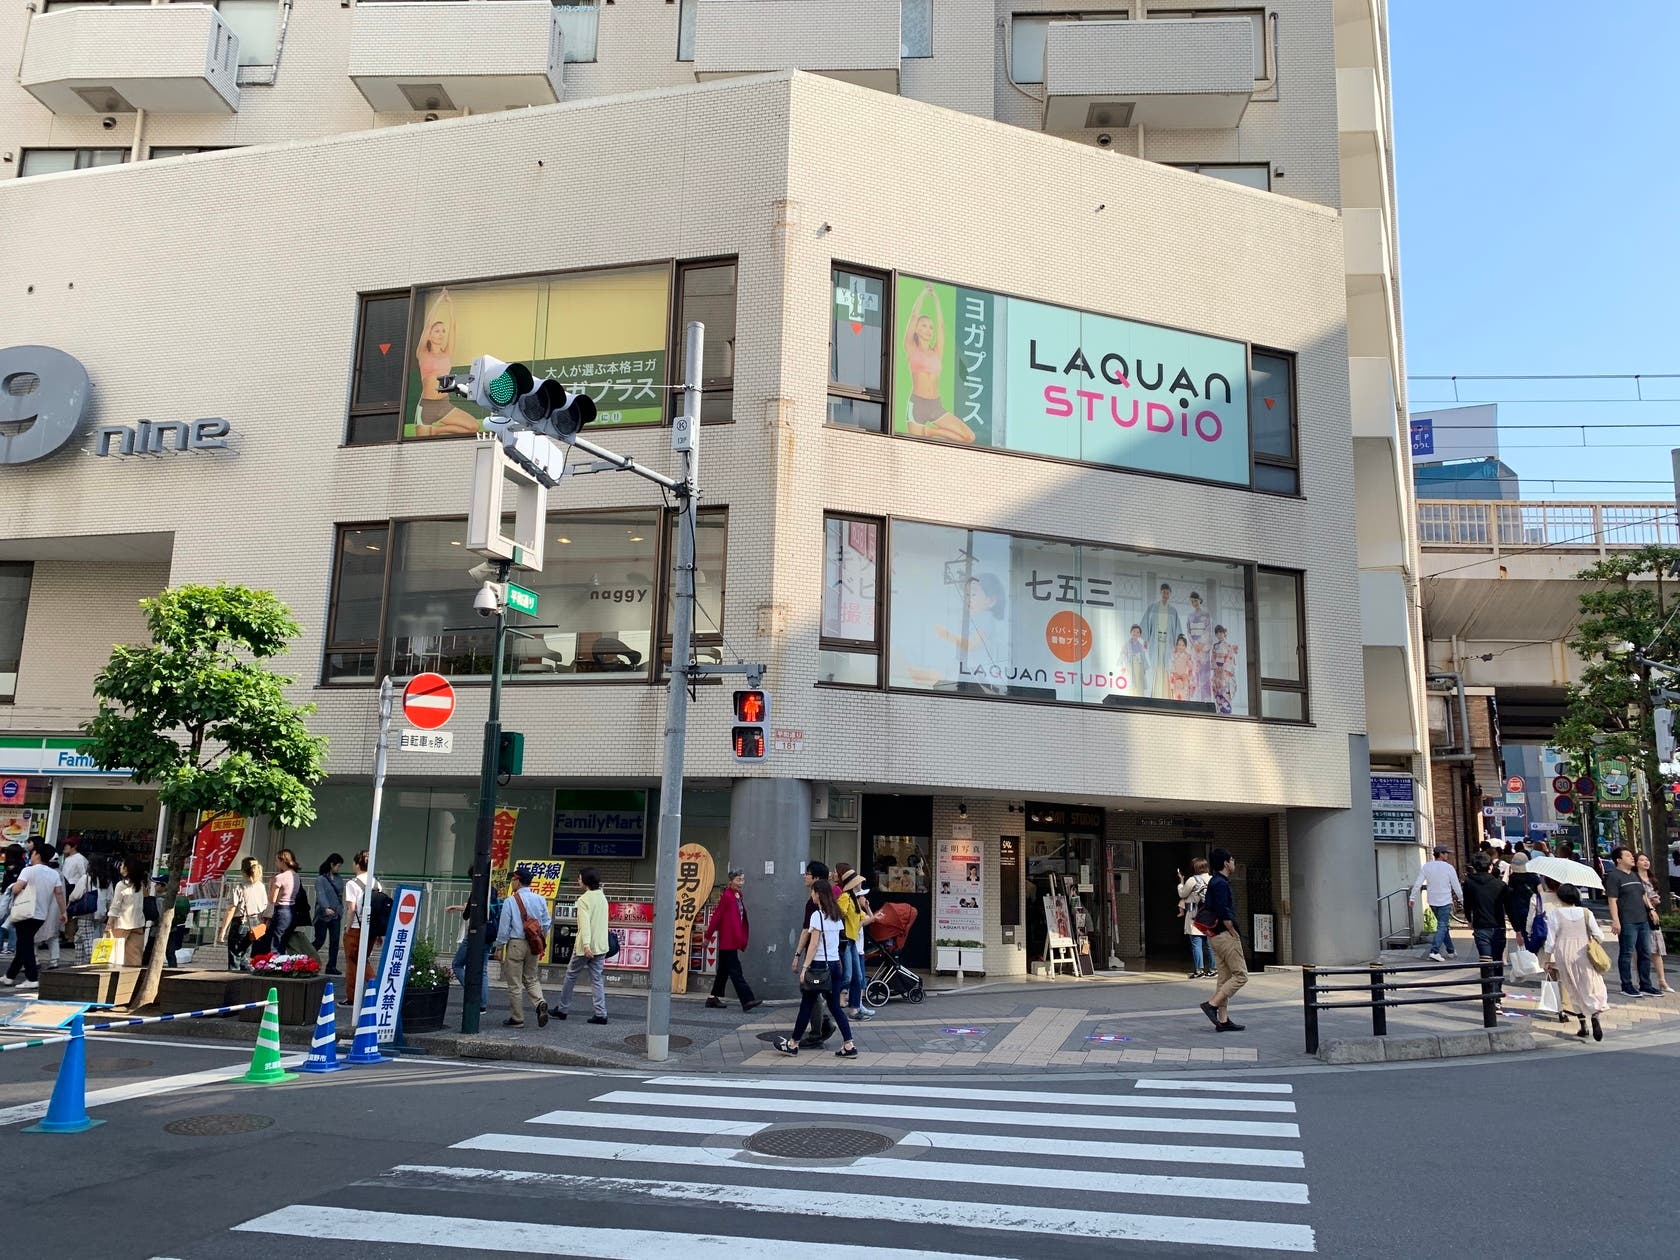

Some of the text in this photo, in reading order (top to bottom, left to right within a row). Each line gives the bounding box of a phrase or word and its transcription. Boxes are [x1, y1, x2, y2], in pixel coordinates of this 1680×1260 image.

[545, 358, 657, 379] 大人が選ぶ本格ヨガ
[962, 297, 987, 425] ヨガプラス
[1030, 339, 1231, 403] LAQUAN
[0, 345, 89, 464] 9
[96, 417, 231, 457] nine
[590, 588, 648, 602] naggy
[1025, 570, 1114, 607] 七五三
[959, 661, 1048, 683] LAQUAN
[400, 735, 449, 748] 自転車を除く
[1557, 780, 1569, 789] 30
[555, 813, 643, 832] FamilyMart
[577, 841, 617, 854] 酒 たばこ
[377, 929, 409, 1027] 車両進入禁止
